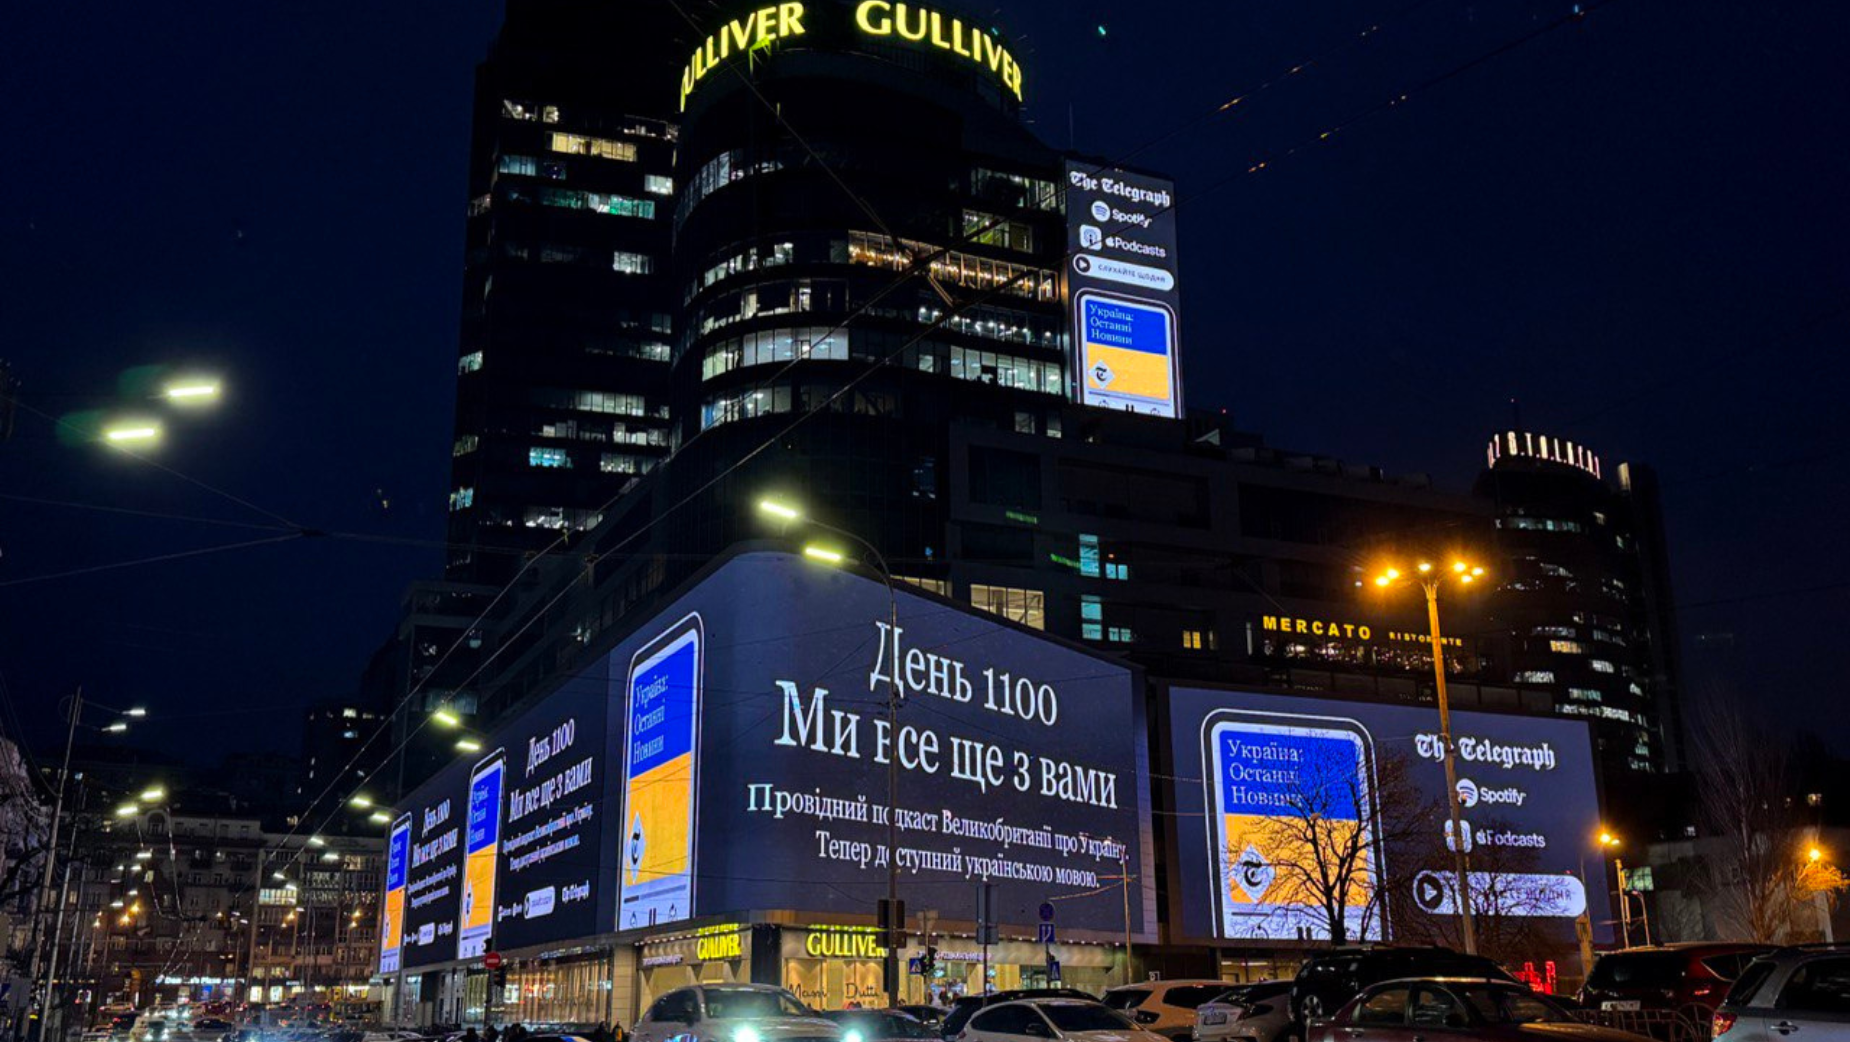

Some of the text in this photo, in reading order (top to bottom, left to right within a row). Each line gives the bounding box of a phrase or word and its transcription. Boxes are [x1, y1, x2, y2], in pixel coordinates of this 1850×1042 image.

[855, 0, 1022, 102] GULLIVER
[1069, 171, 1170, 207] The Telegraph
[1112, 208, 1152, 228] Spotify
[1115, 237, 1166, 257] Podcasts
[1090, 304, 1133, 321] Україна:
[1090, 316, 1132, 333] Останні
[1091, 329, 1132, 345] Новини
[1262, 616, 1371, 640] MERCATO
[1389, 632, 1463, 646] RISTORNTE
[870, 620, 1058, 726] День 1100
[551, 718, 575, 756] 1100
[774, 680, 861, 759] Ми
[950, 736, 1004, 793] ще
[1013, 751, 1031, 792] з
[1040, 757, 1118, 809] вами
[1227, 738, 1304, 763] Україна:
[1414, 734, 1556, 770] Th Telegraph
[1480, 787, 1524, 806] Spotify
[747, 784, 868, 821] Провідний
[942, 810, 1052, 848] Великобританії
[1055, 834, 1078, 857] про
[816, 830, 871, 869] Тепер
[965, 853, 1053, 881] українською
[1056, 867, 1100, 888] мовою.
[697, 933, 742, 960] GULLIVER
